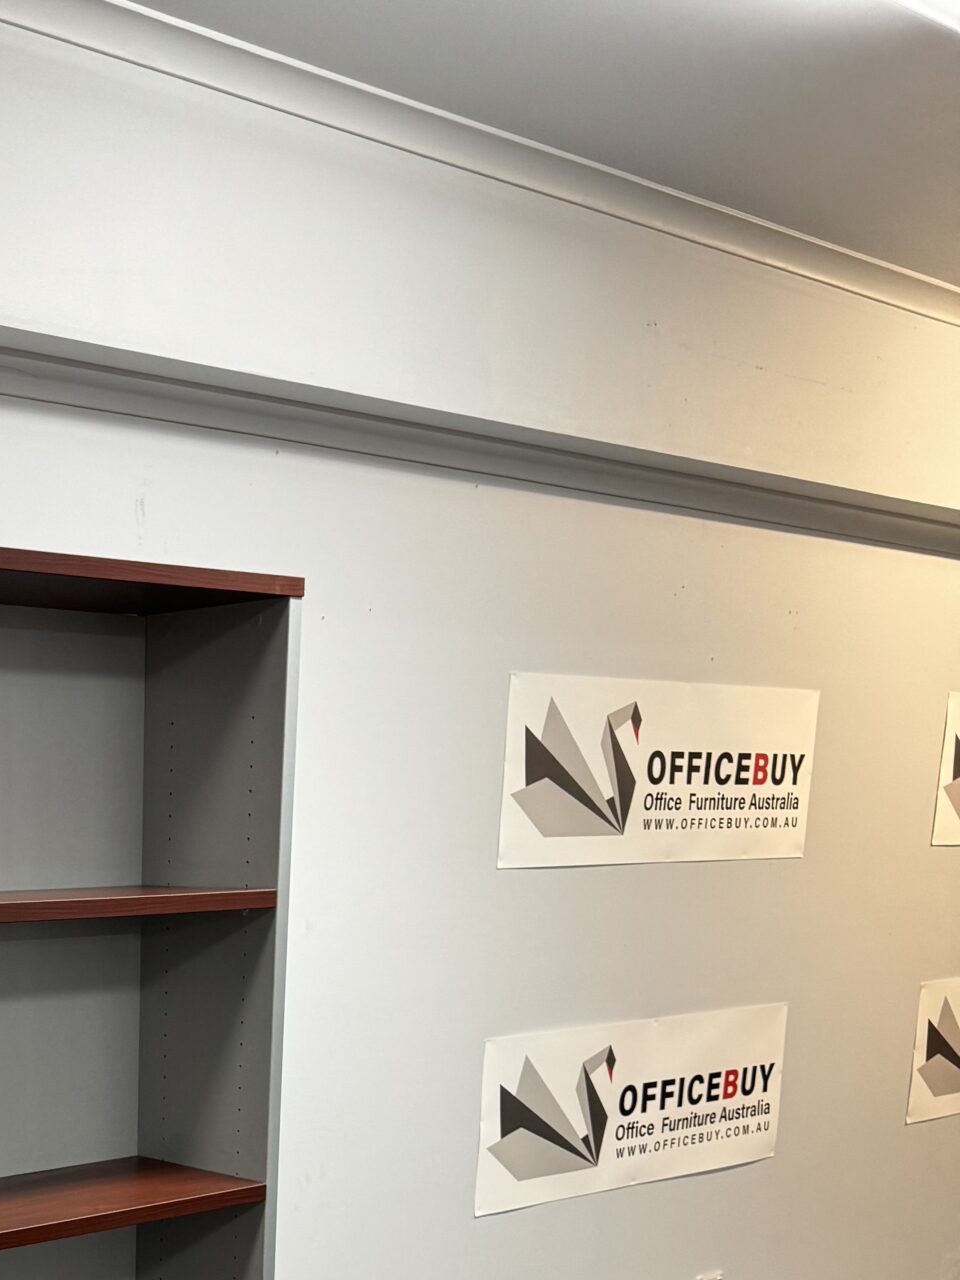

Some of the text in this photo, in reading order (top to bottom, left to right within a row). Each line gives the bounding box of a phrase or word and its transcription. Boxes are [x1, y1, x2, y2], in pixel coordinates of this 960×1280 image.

[647, 750, 806, 785] OFFICEBUY
[643, 792, 799, 811] Office Furniture Australia
[643, 816, 798, 830] WWW.OFFICEBUY.COM.AU
[618, 1063, 775, 1117] OFFICEBUY
[615, 1099, 770, 1141] Office Furniture Australia
[615, 1120, 770, 1159] WWW.OFFICEBUY.COM.AU
